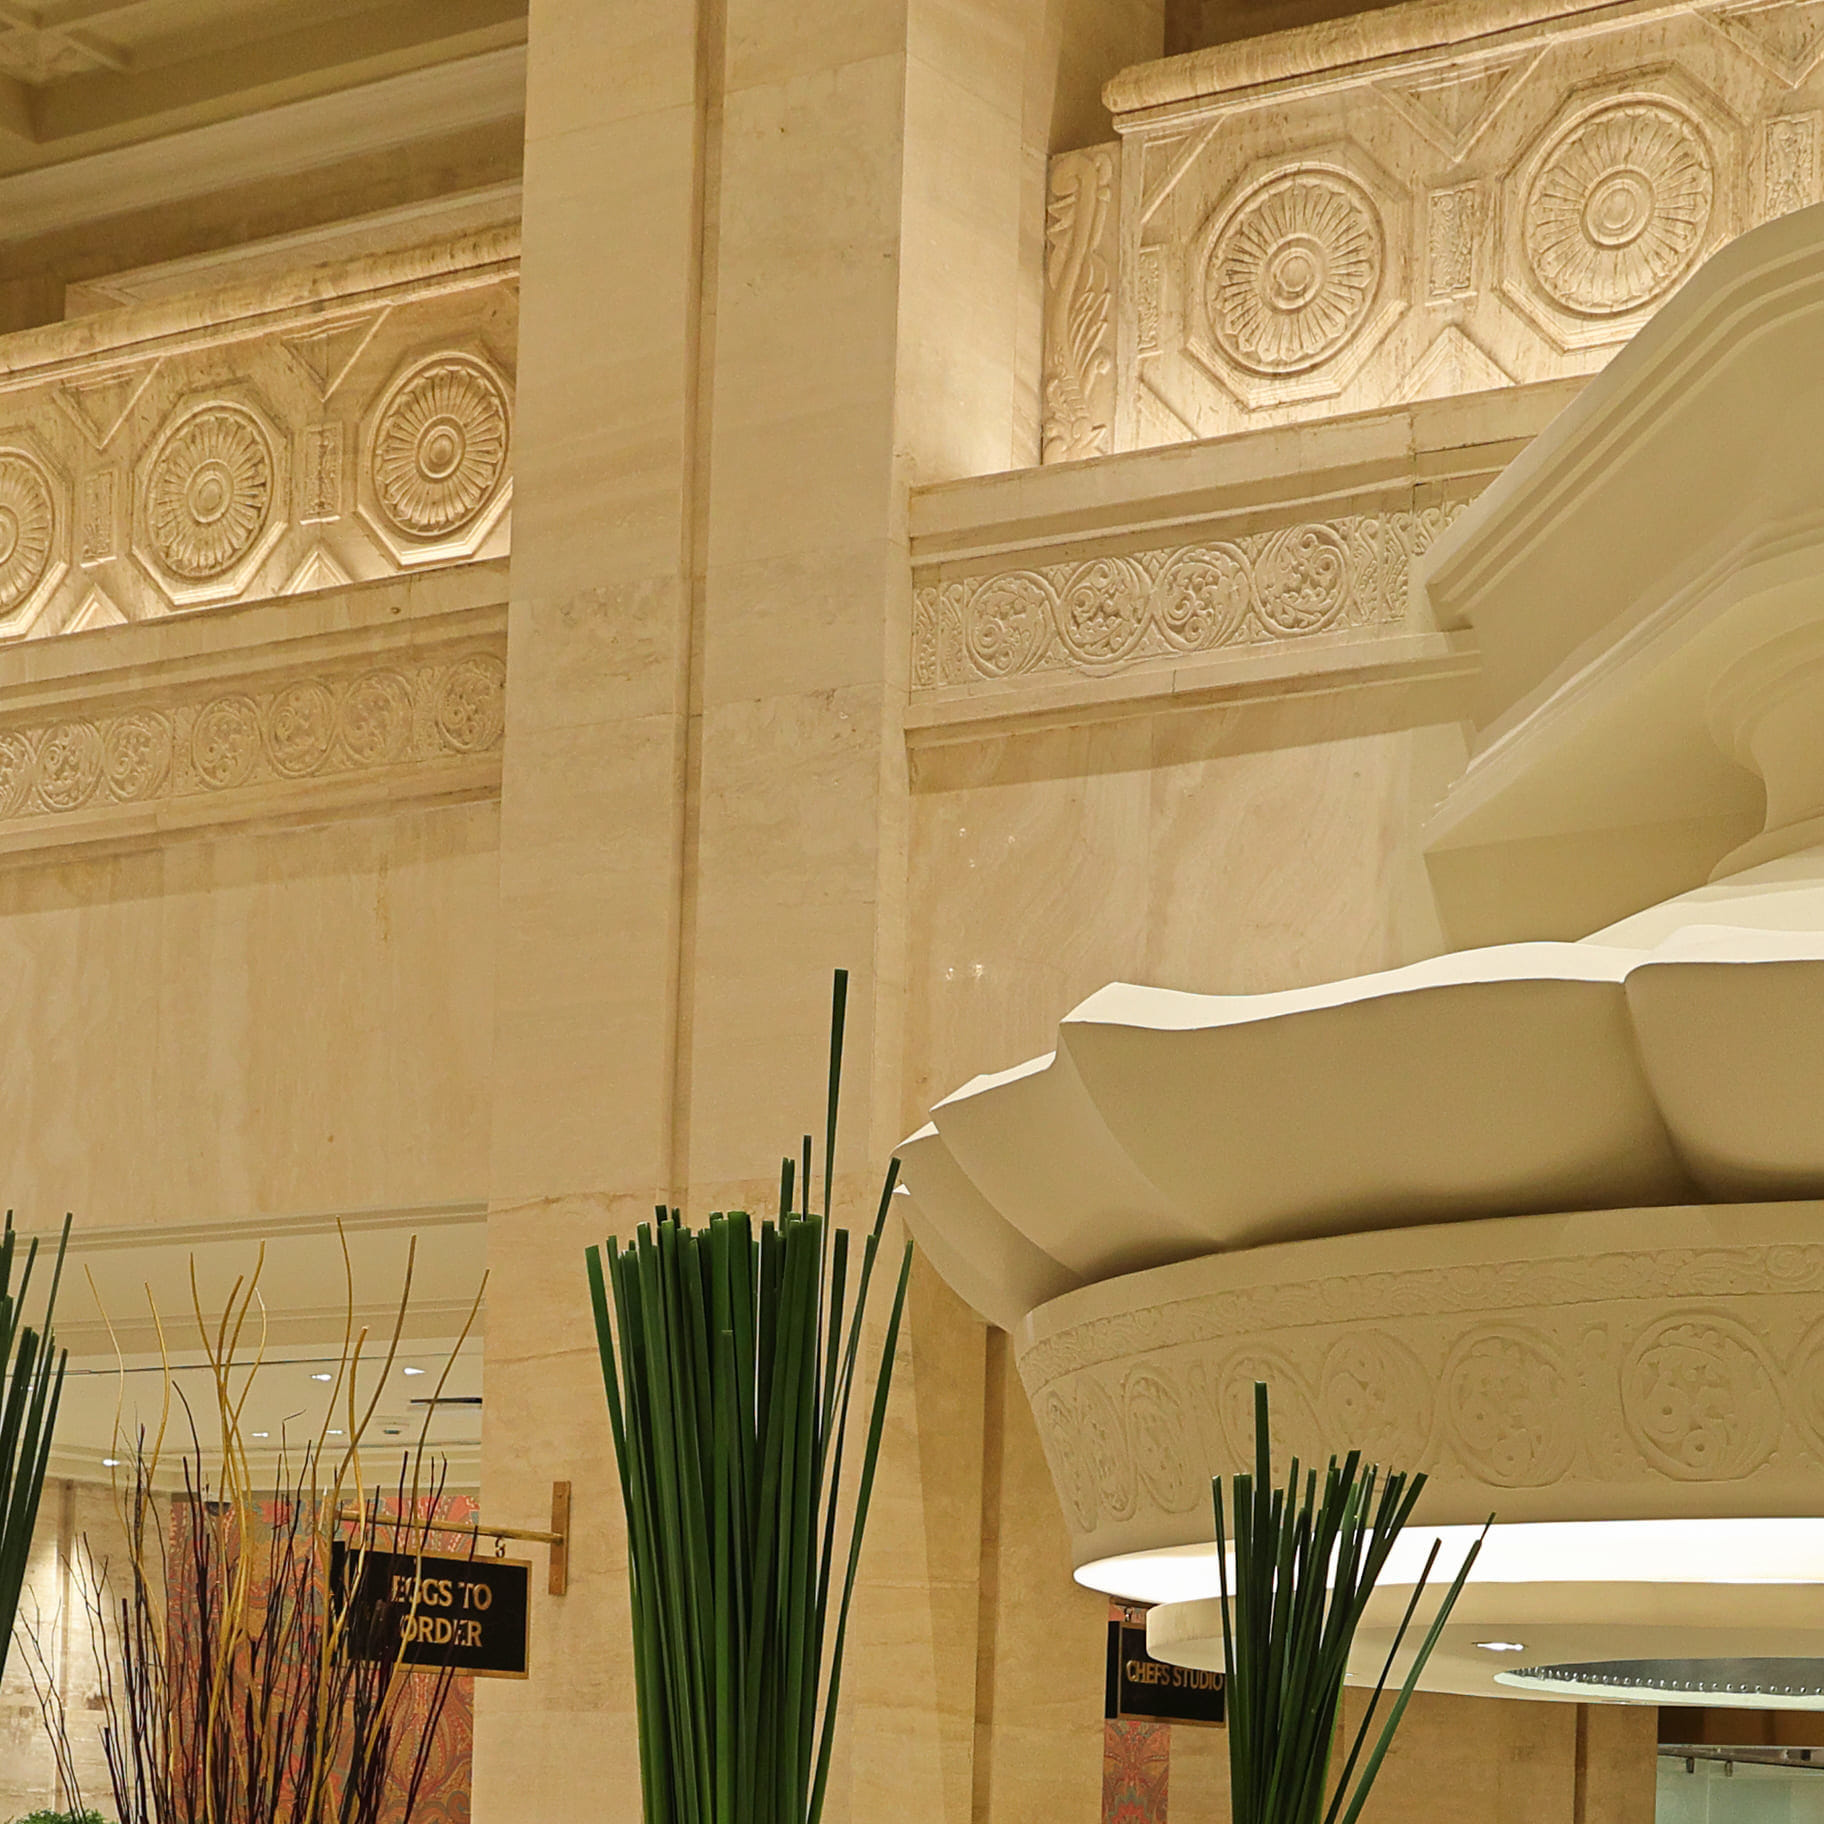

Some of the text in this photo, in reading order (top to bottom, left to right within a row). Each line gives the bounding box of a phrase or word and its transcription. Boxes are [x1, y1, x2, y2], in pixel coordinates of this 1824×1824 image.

[391, 1575, 493, 1611] EGGS TO
[400, 1614, 483, 1648] ORDER
[1172, 1666, 1224, 1691] STUDIO
